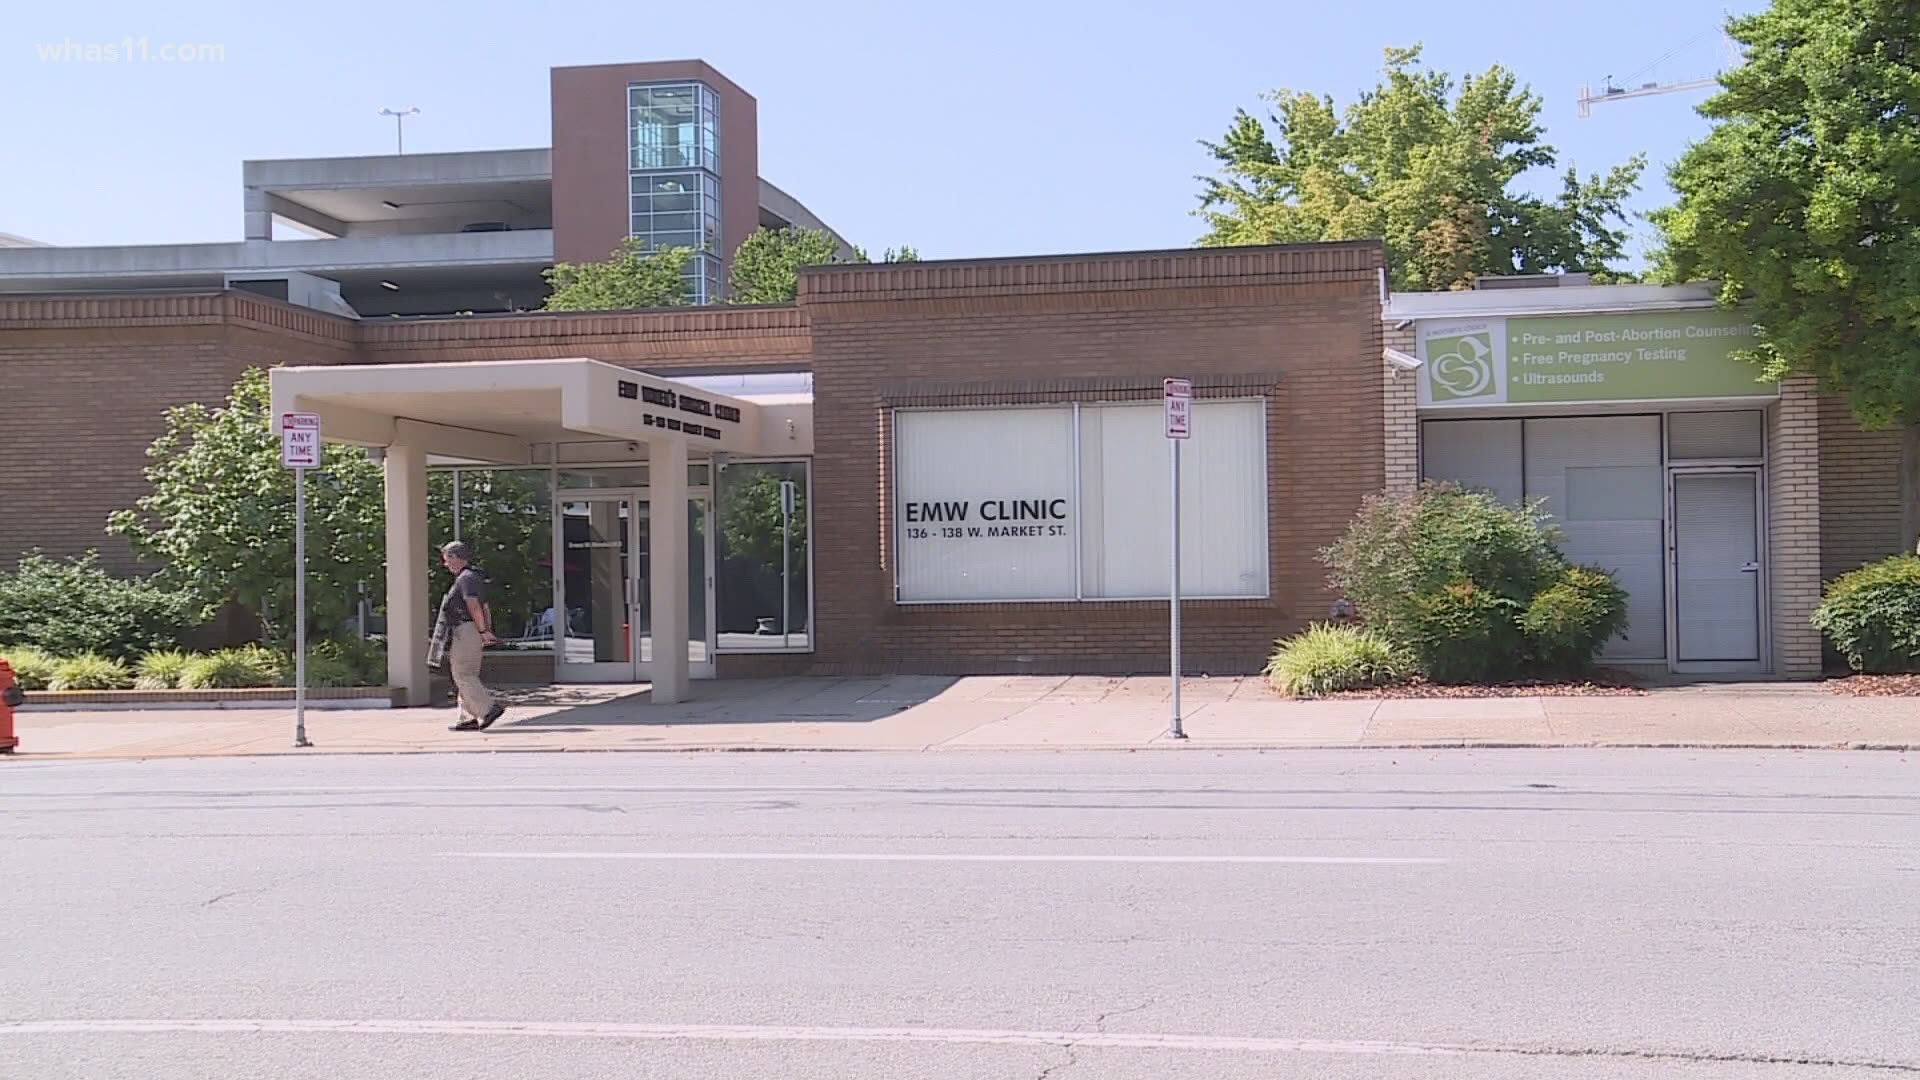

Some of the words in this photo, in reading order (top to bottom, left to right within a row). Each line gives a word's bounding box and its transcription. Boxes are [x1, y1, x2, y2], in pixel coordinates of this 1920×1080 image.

[1523, 333, 1552, 345] Pre-
[1555, 332, 1581, 344] and
[1585, 327, 1681, 343] Post-Abortion
[1686, 325, 1755, 338] Counselin
[1523, 352, 1554, 365] Free
[1558, 351, 1633, 366] Pregnancy
[1636, 347, 1687, 361] Testing
[1523, 370, 1605, 385] Ultrasounds
[1170, 400, 1185, 411] ANY
[291, 432, 312, 442] ANY
[290, 445, 312, 456] TIME
[906, 501, 969, 522] EMW
[979, 498, 1066, 521] CLINIC
[907, 528, 928, 539] 136
[943, 527, 963, 538] 138
[968, 527, 983, 537] W.
[988, 525, 1044, 537] MARKET
[1048, 524, 1067, 536] ST.
